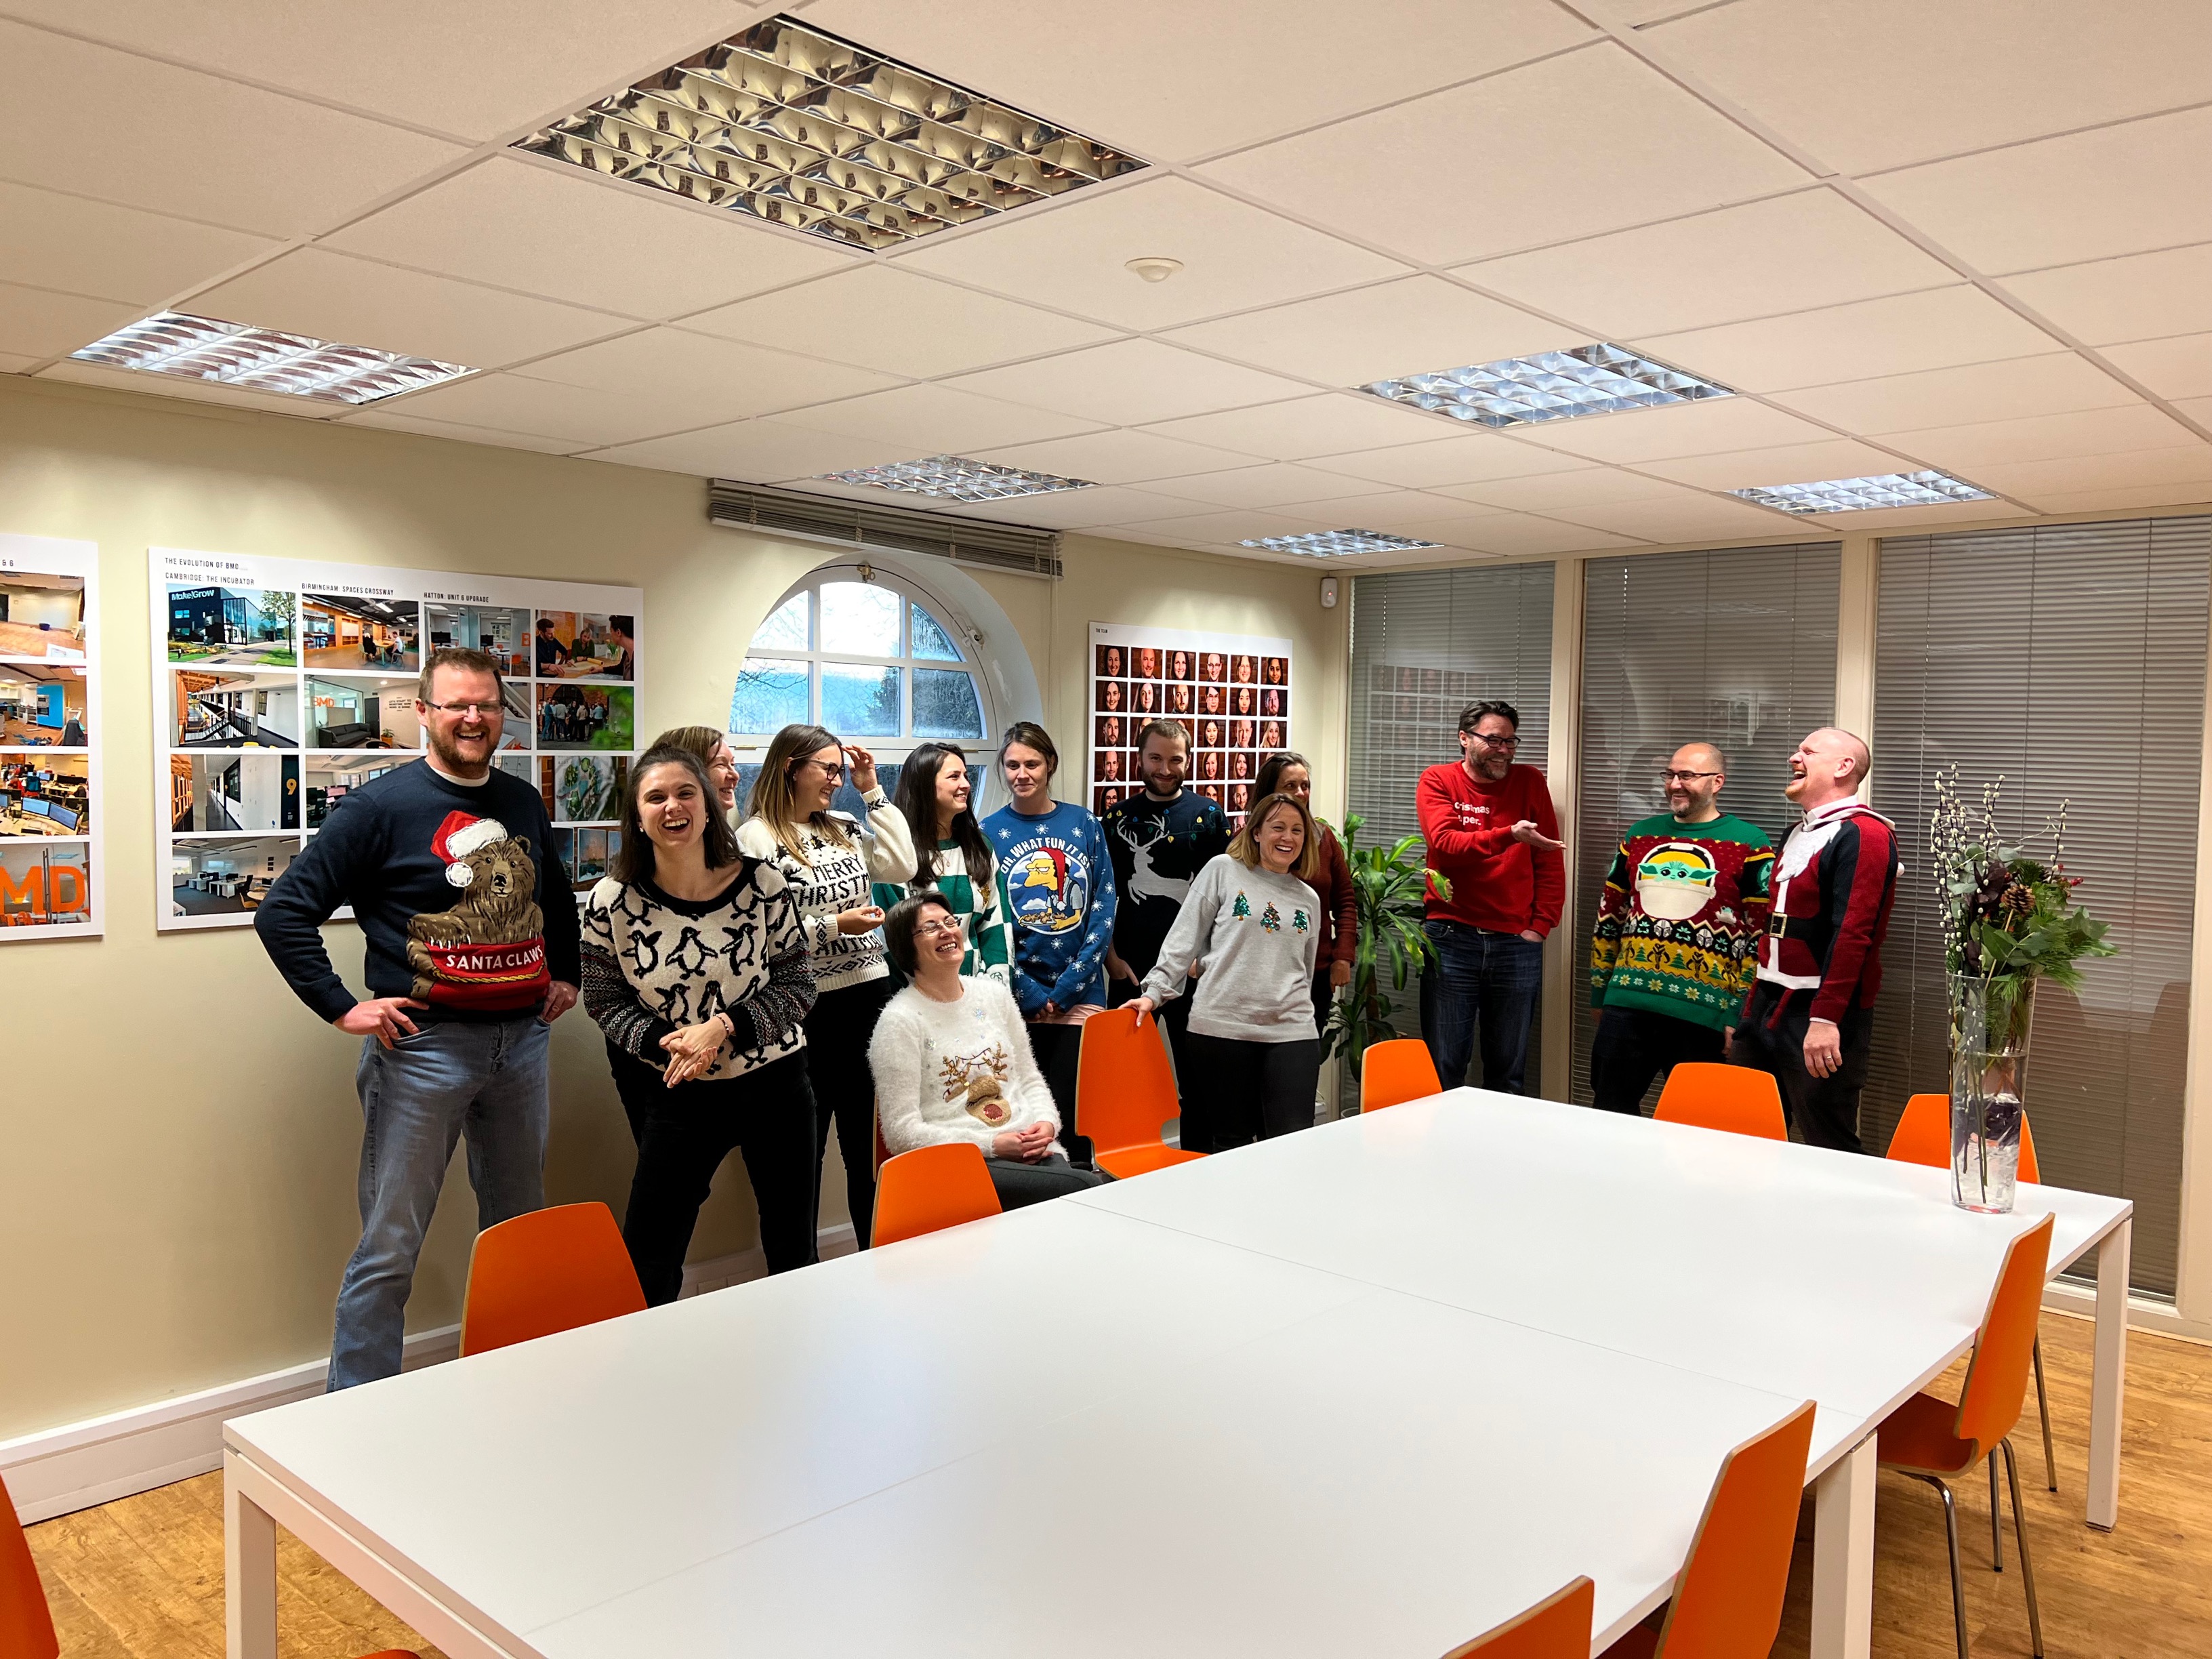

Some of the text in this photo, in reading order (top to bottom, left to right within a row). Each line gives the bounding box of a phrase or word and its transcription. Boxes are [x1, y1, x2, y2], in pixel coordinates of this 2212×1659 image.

[180, 558, 213, 567] EVOLUTION
[165, 573, 205, 581] CAMBRIDGE:
[221, 577, 254, 586] INCUBATOR
[302, 583, 340, 592] BIRMINGHAM:
[365, 588, 394, 596] CROSSWAY
[286, 778, 297, 795] 9
[1010, 838, 1042, 858] WHAT
[1044, 837, 1066, 851] FUN
[1065, 844, 1078, 855] IT
[813, 854, 863, 882] MERRY
[446, 945, 543, 970] SANTA CLAWS
